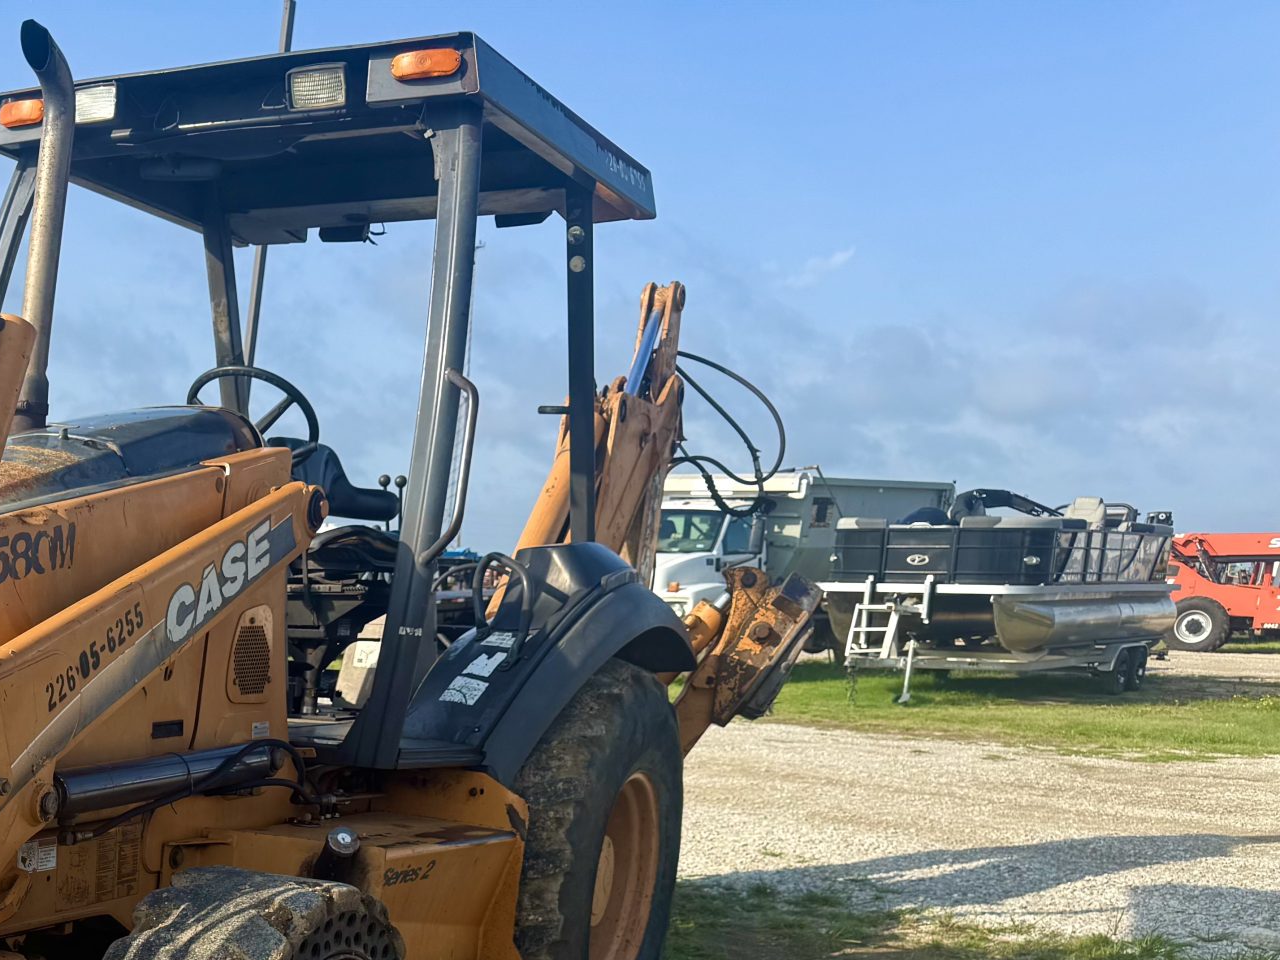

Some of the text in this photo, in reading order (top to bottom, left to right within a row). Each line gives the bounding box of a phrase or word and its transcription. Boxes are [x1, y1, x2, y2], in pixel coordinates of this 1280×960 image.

[166, 518, 271, 643] CASE
[383, 859, 436, 887] Series 2
